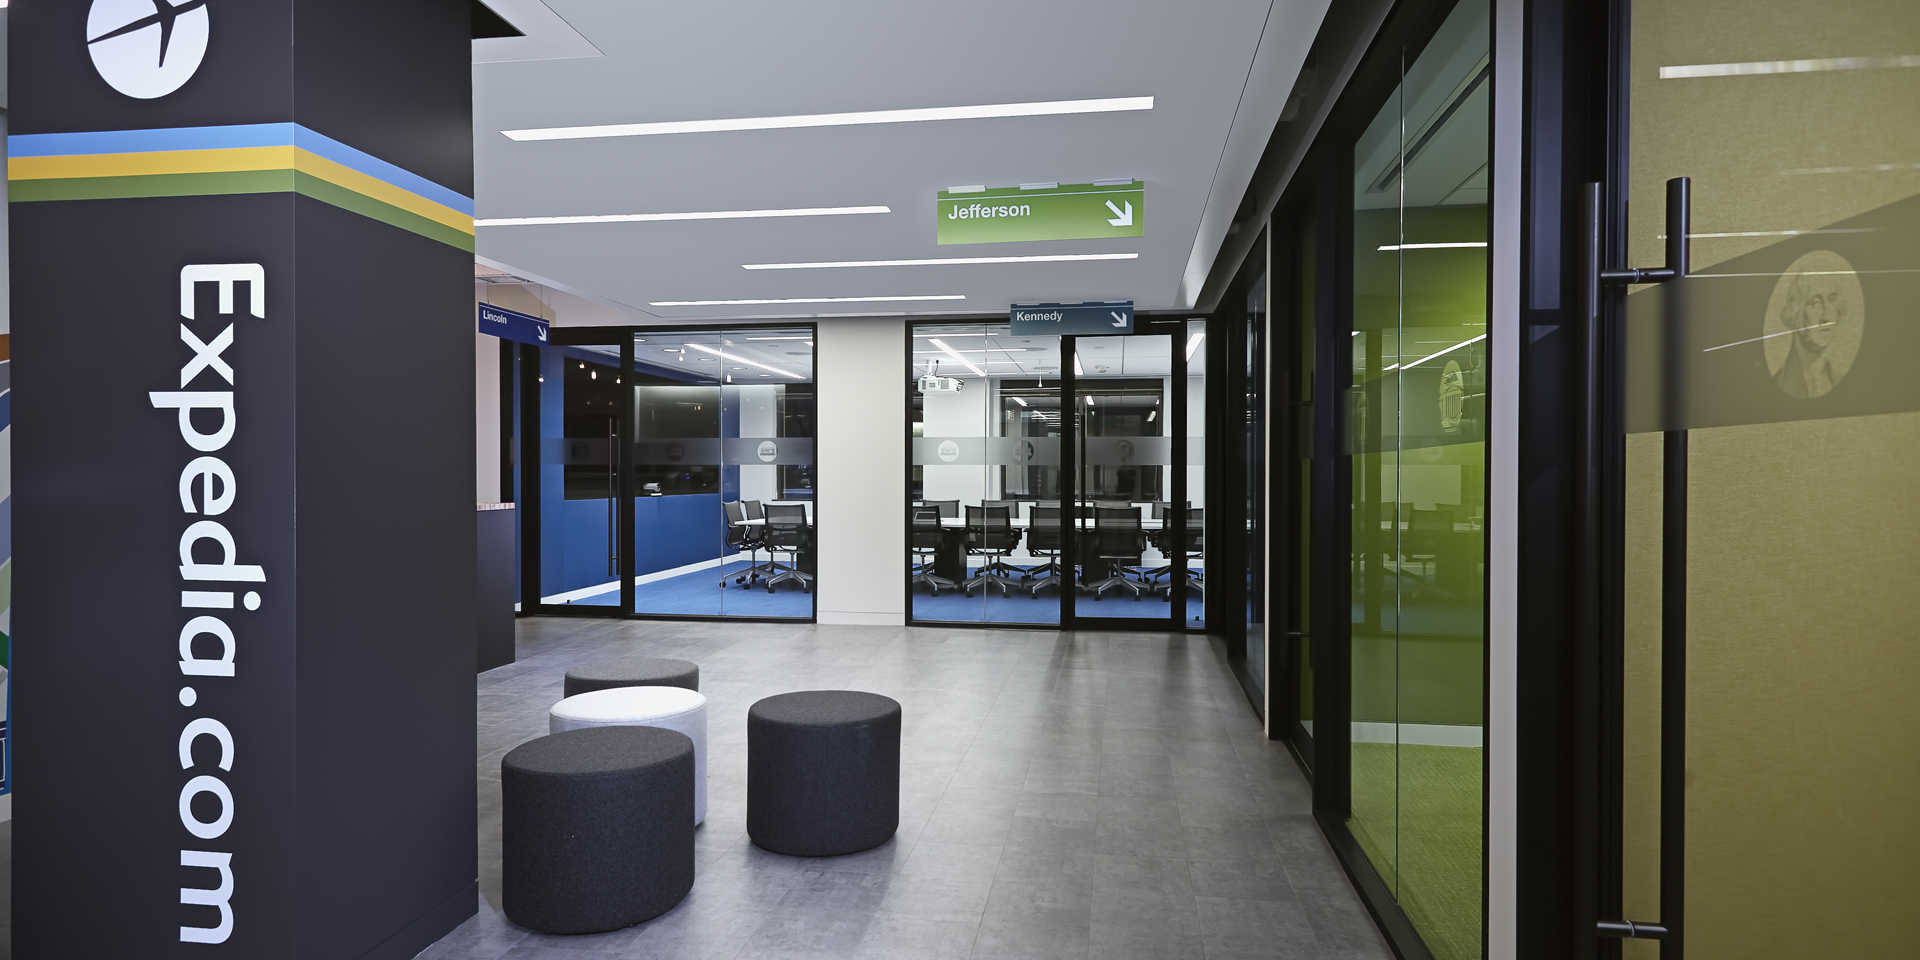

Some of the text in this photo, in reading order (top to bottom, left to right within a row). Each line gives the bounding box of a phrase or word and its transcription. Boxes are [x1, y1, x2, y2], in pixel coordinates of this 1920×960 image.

[948, 203, 1031, 220] Jefferson
[482, 310, 507, 324] Lincoln
[1016, 311, 1063, 323] Kennedy
[149, 263, 266, 944] Expedia.com
